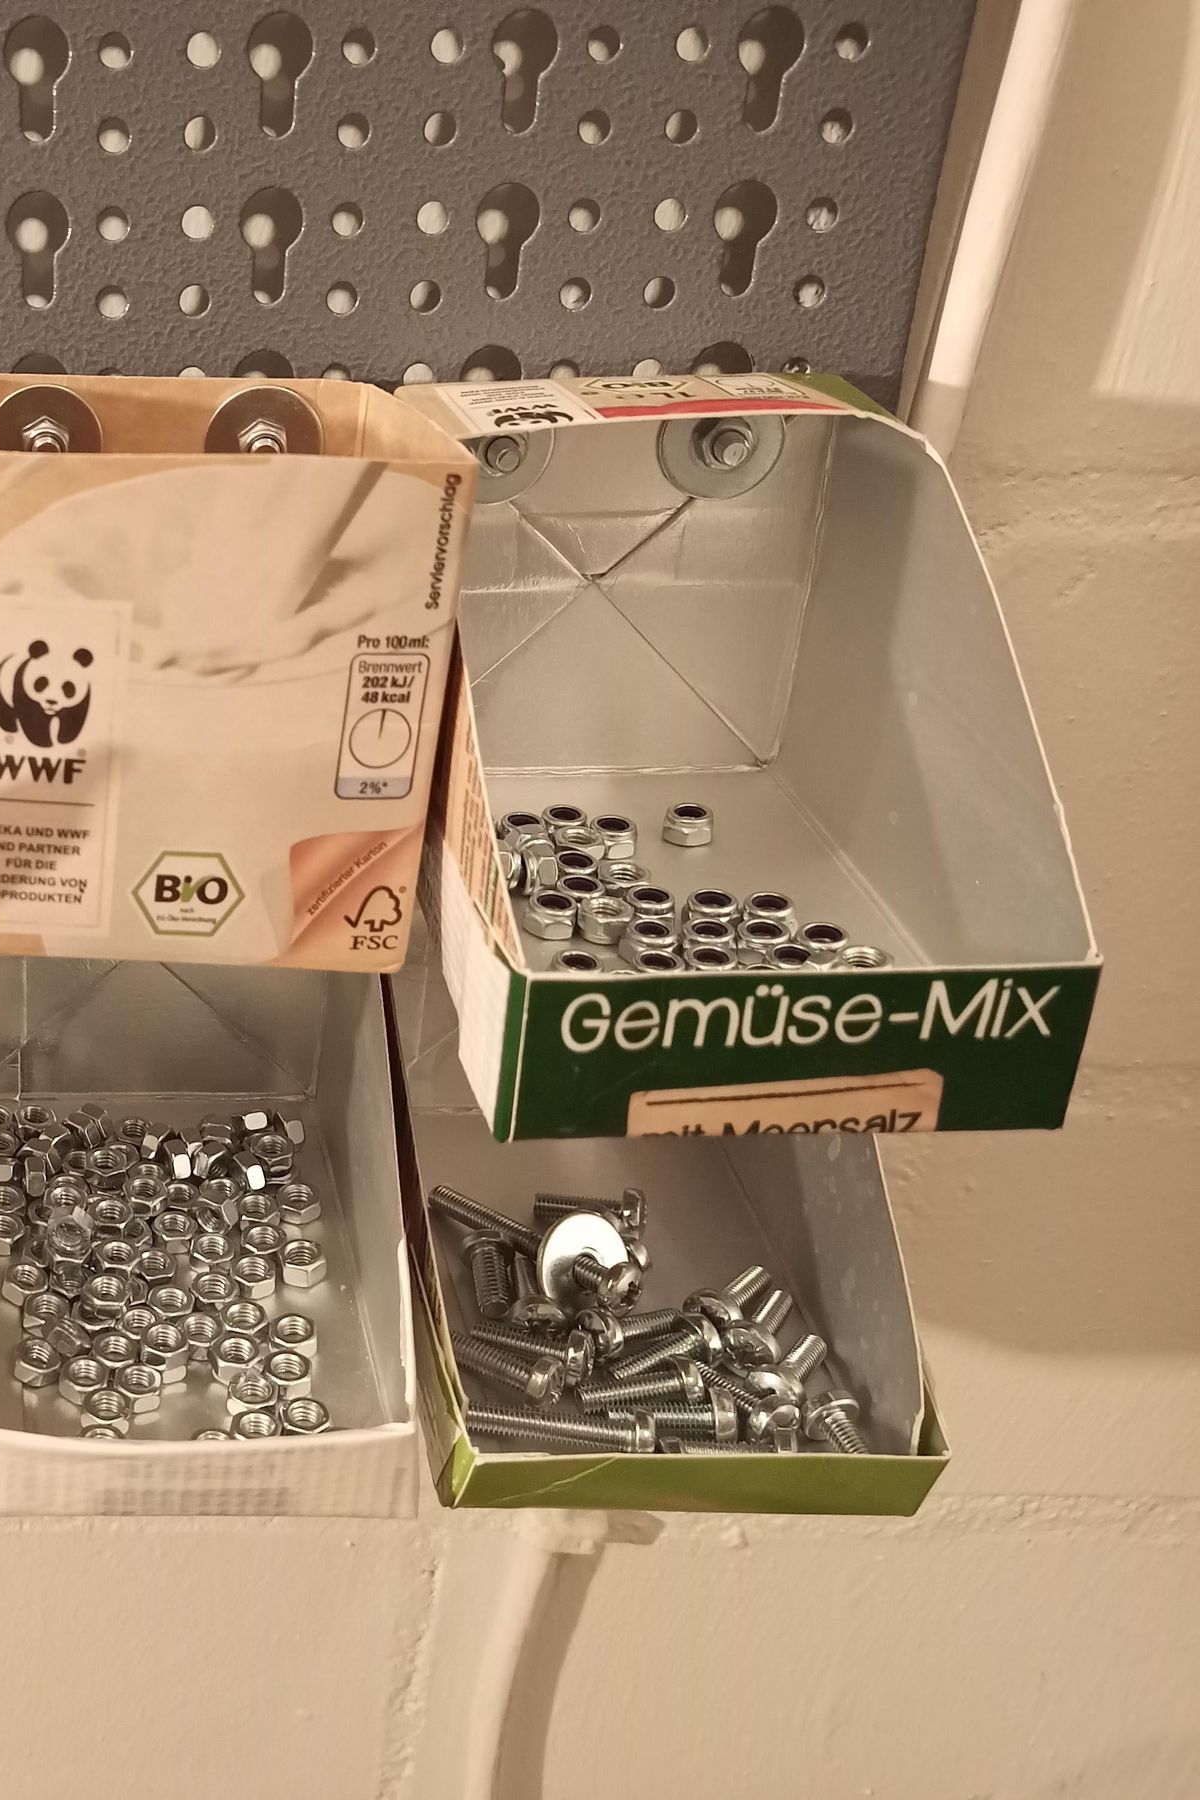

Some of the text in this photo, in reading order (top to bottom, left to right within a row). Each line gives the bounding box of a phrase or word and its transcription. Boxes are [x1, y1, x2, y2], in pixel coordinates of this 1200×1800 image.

[425, 473, 462, 611] Serviervorschlag
[357, 635, 380, 649] Pro
[358, 660, 423, 674] Brennwert
[361, 675, 415, 689] 202 kJ/
[361, 691, 411, 704] 48 kcal
[25, 826, 54, 839] UND
[57, 828, 90, 840] WWF
[18, 842, 81, 856] PARTNER
[5, 856, 57, 871] FÜR DIE
[60, 877, 87, 889] VON
[306, 841, 388, 916] zertifizierter Karton
[349, 934, 399, 951] FSC
[560, 978, 1063, 1053] Gemüse-Mix
